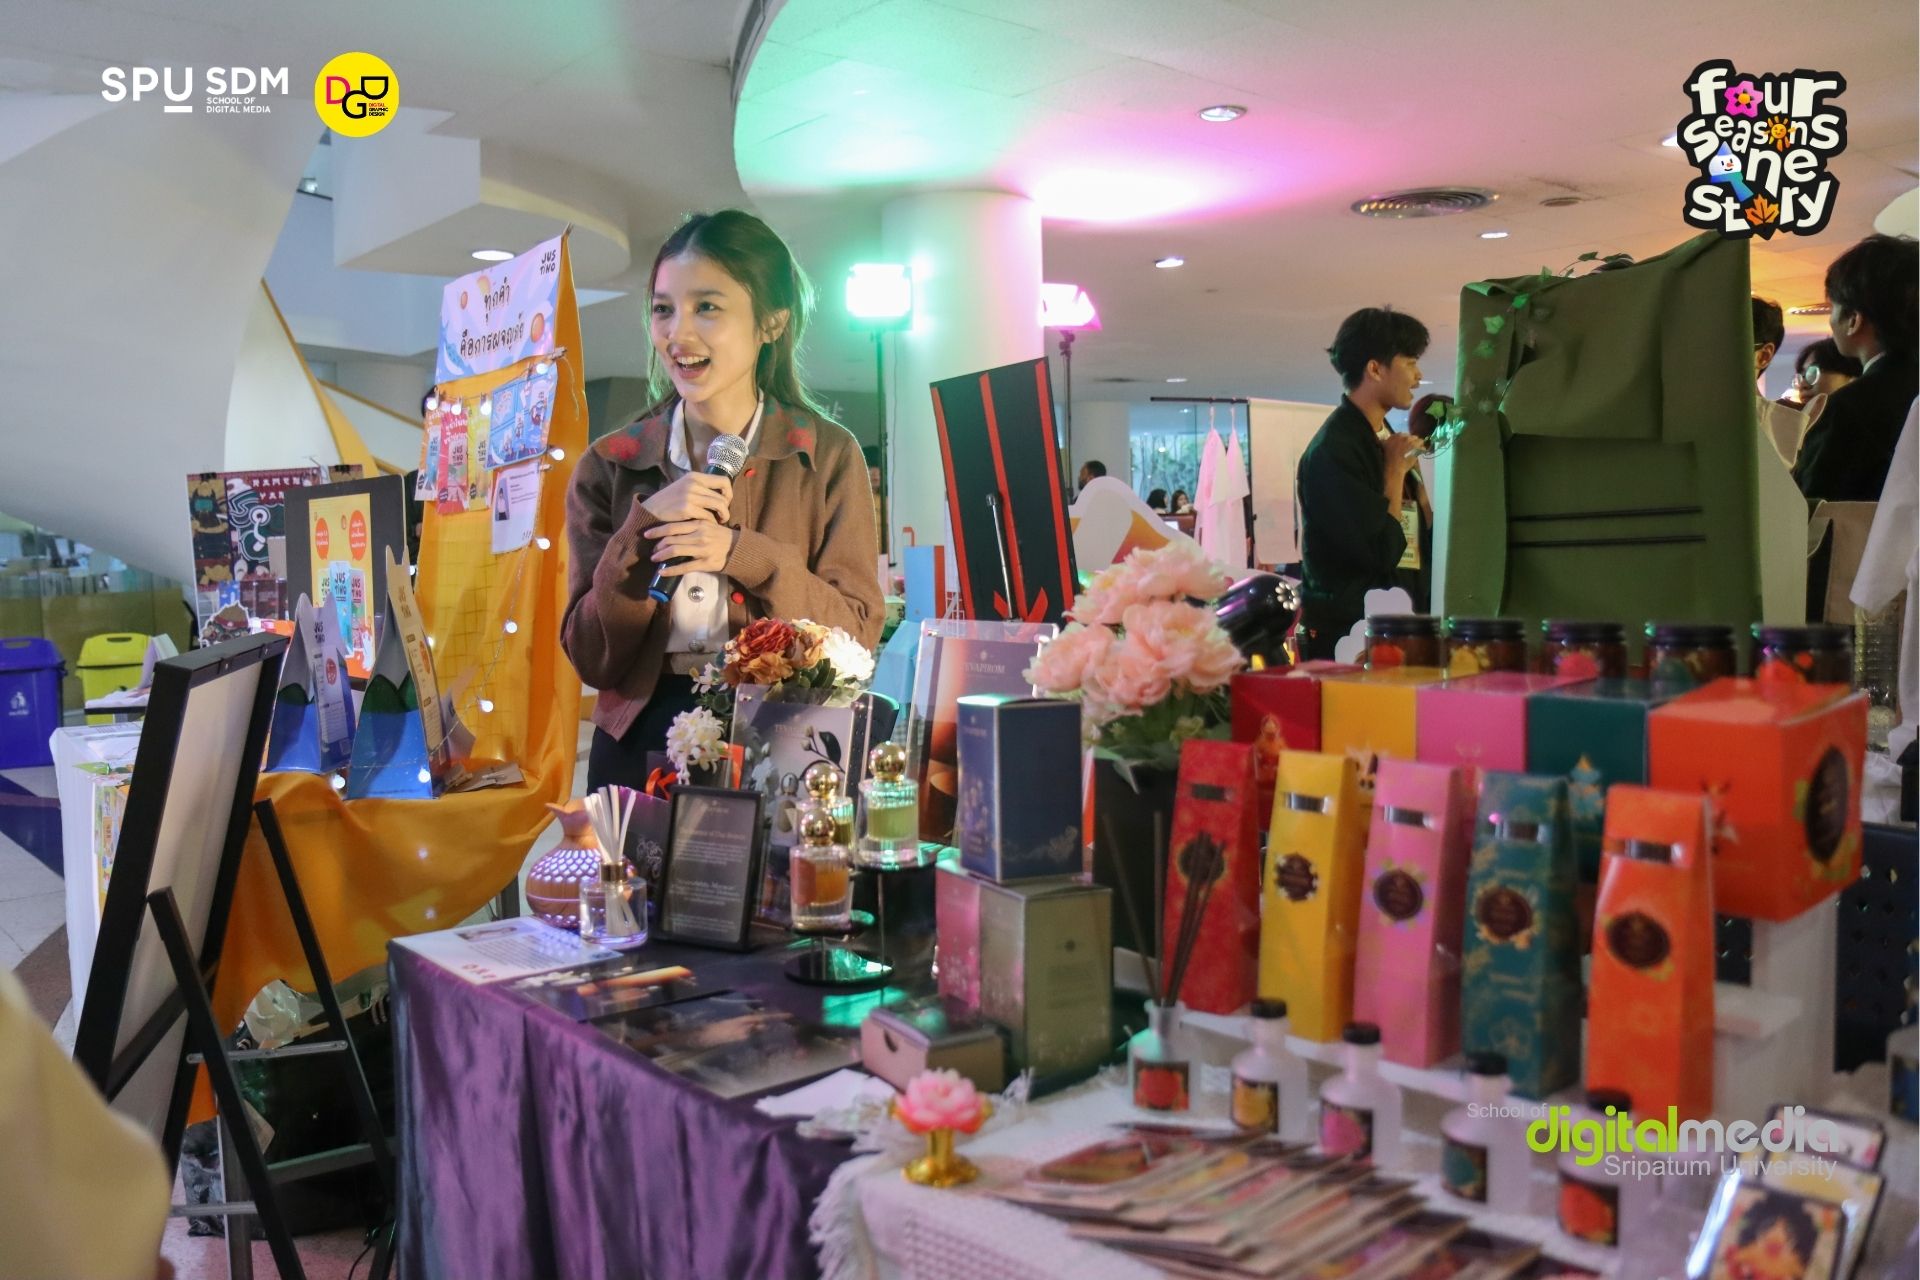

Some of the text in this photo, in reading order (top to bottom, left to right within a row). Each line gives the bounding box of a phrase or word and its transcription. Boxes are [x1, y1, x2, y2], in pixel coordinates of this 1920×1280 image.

[541, 249, 557, 265] JUS
[252, 477, 301, 488] RAMEN
[334, 571, 346, 585] JUS
[351, 576, 361, 589] JUS
